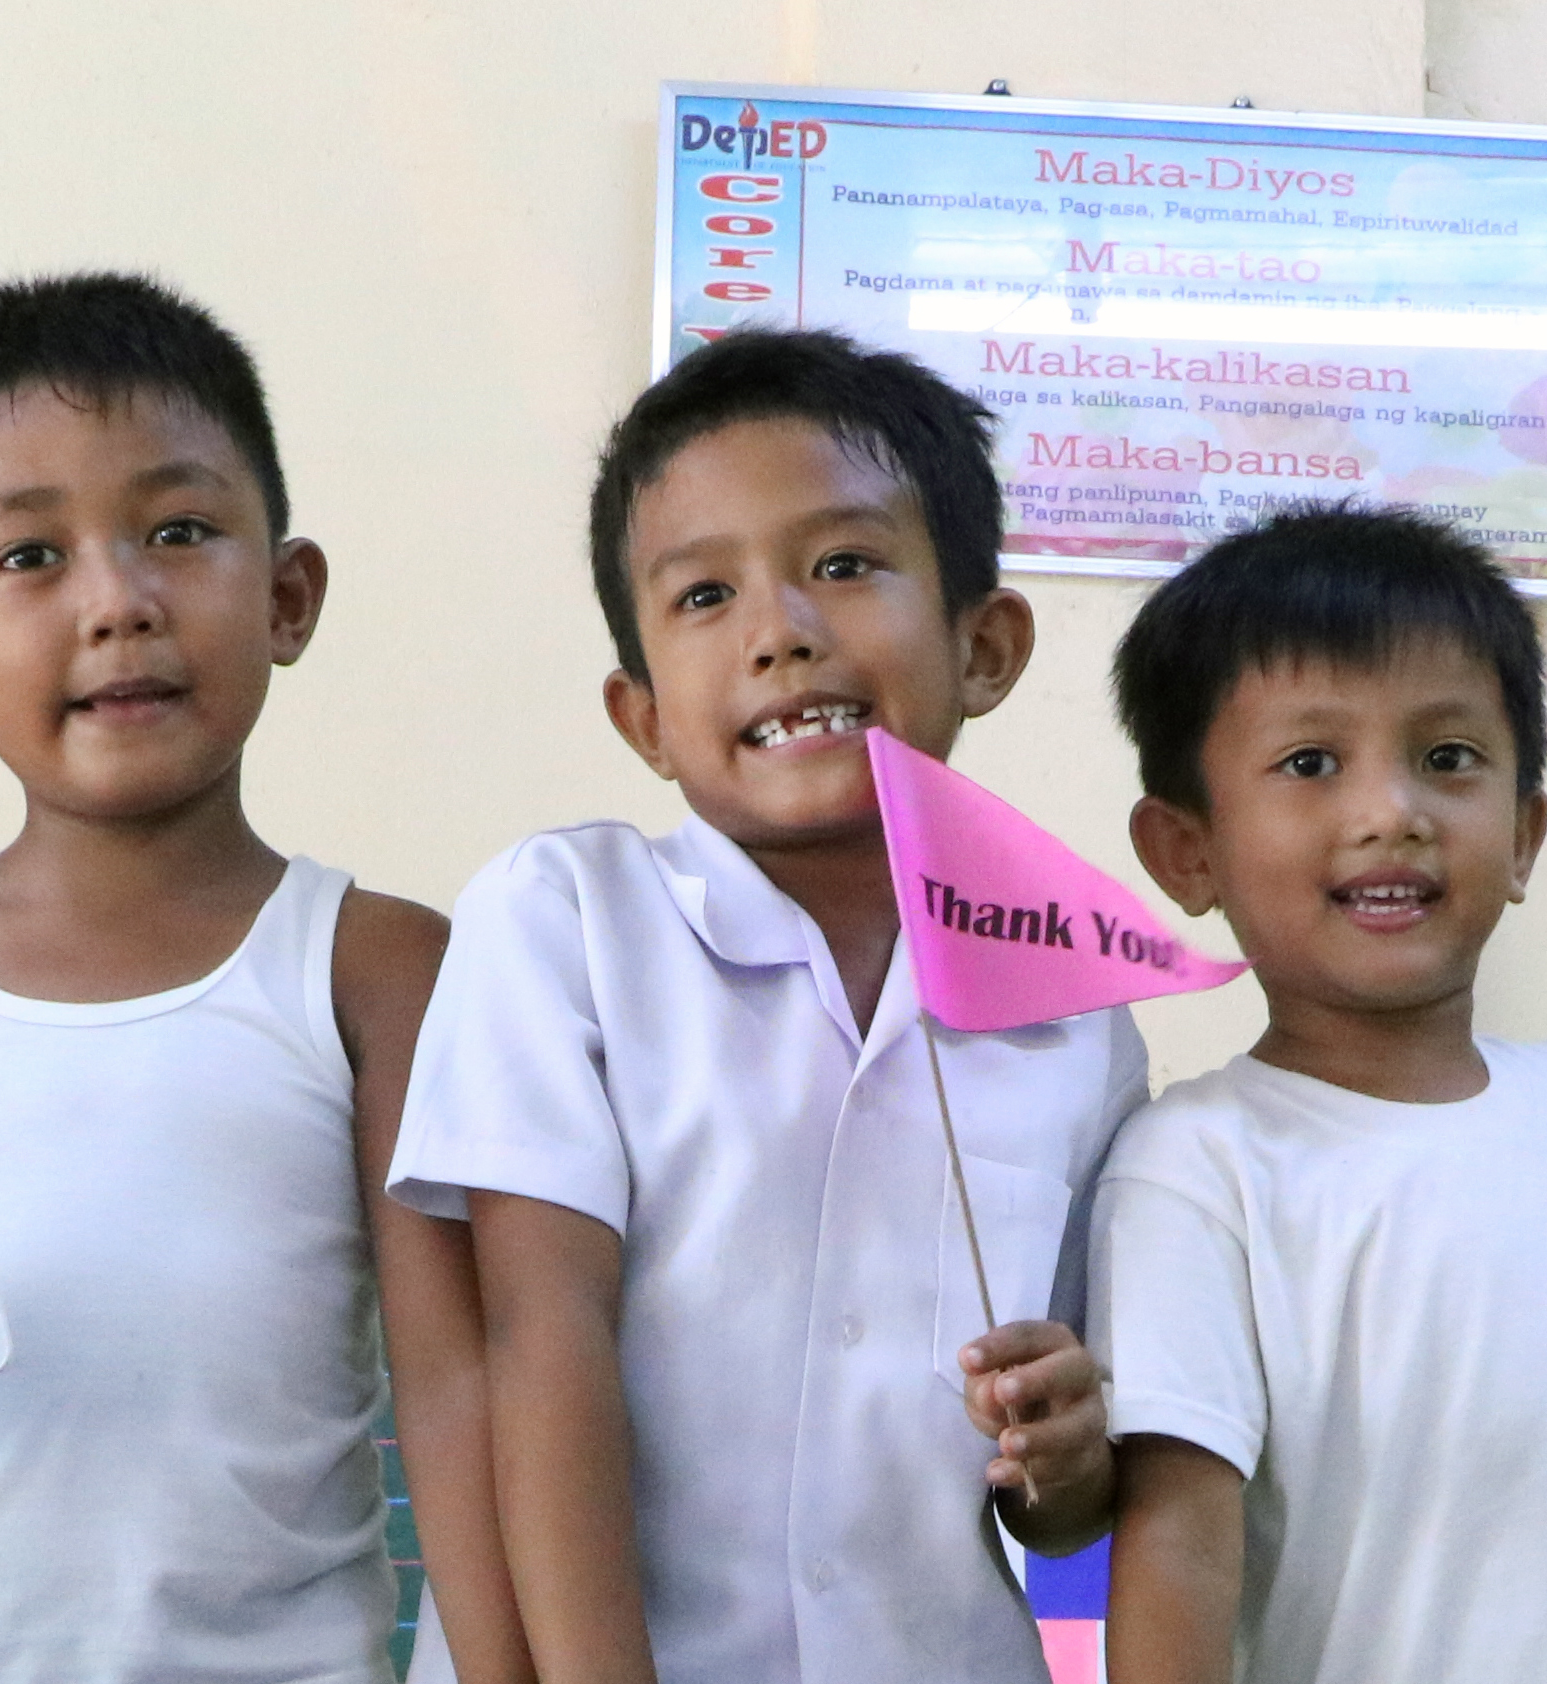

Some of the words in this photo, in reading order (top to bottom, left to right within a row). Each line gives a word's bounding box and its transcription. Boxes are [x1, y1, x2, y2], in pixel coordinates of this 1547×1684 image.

[1034, 147, 1356, 200] Maka-Diyos
[832, 185, 1049, 216] Pananampalataya,
[1058, 196, 1155, 220] Pag-asa,
[1165, 201, 1324, 229] Pagmamahal,
[1332, 210, 1519, 239] Espirituwalidad
[844, 268, 954, 295] Pagdama
[964, 277, 986, 292] at
[1065, 239, 1322, 285] Maka-tao
[979, 339, 1411, 393] Maka-kalikasan
[964, 384, 1028, 407] alaga
[1037, 391, 1062, 405] sa
[1071, 389, 1190, 413] kalikasan,
[1199, 394, 1366, 423] Pangangalaga
[1376, 409, 1406, 428] ng
[1413, 407, 1546, 431] kapaligiran
[1027, 432, 1365, 481] Maka-bansa
[998, 482, 1060, 503] tang
[1067, 484, 1209, 512] panlipunan,
[1021, 502, 1216, 530] Pagmamalasakit
[919, 873, 1074, 951] Thank
